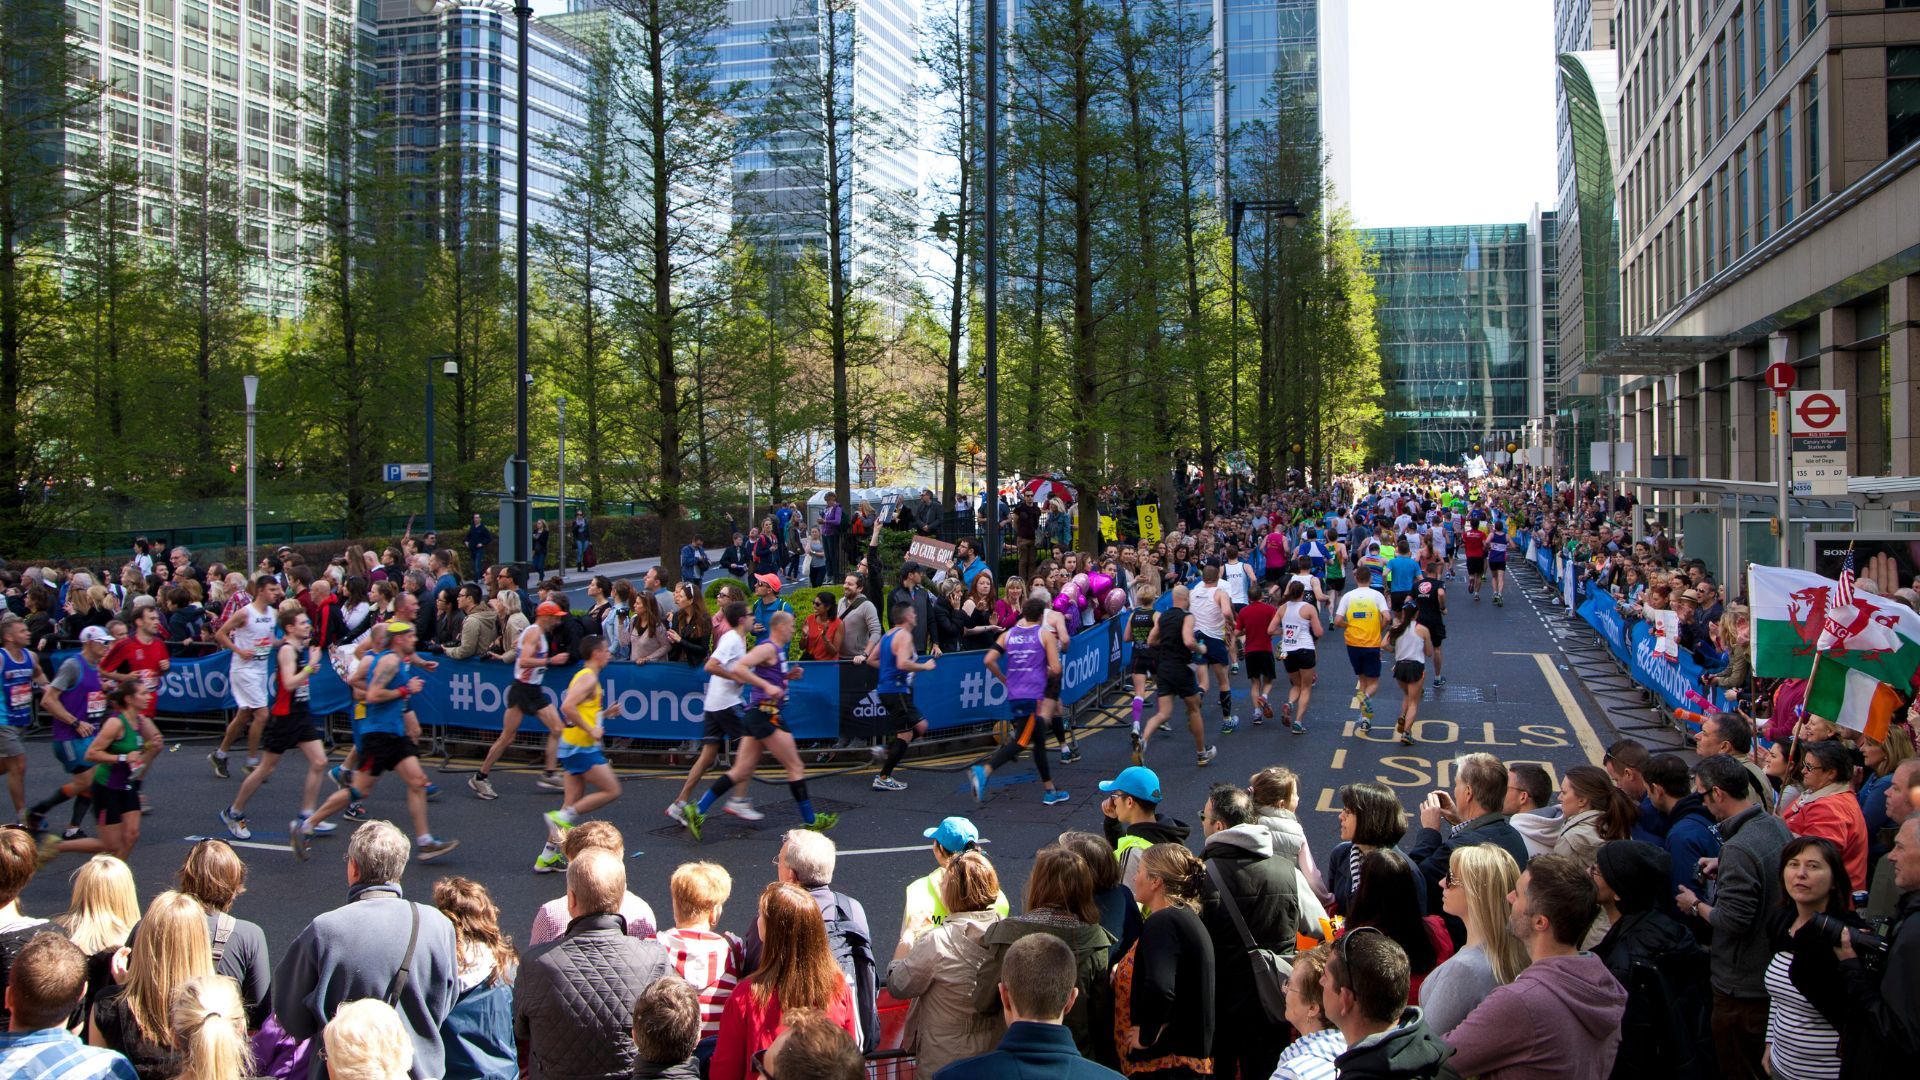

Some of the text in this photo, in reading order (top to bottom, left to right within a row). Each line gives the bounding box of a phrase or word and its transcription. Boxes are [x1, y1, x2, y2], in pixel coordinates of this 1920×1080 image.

[1773, 368, 1788, 388] L
[390, 466, 400, 479] P
[910, 541, 920, 556] GO
